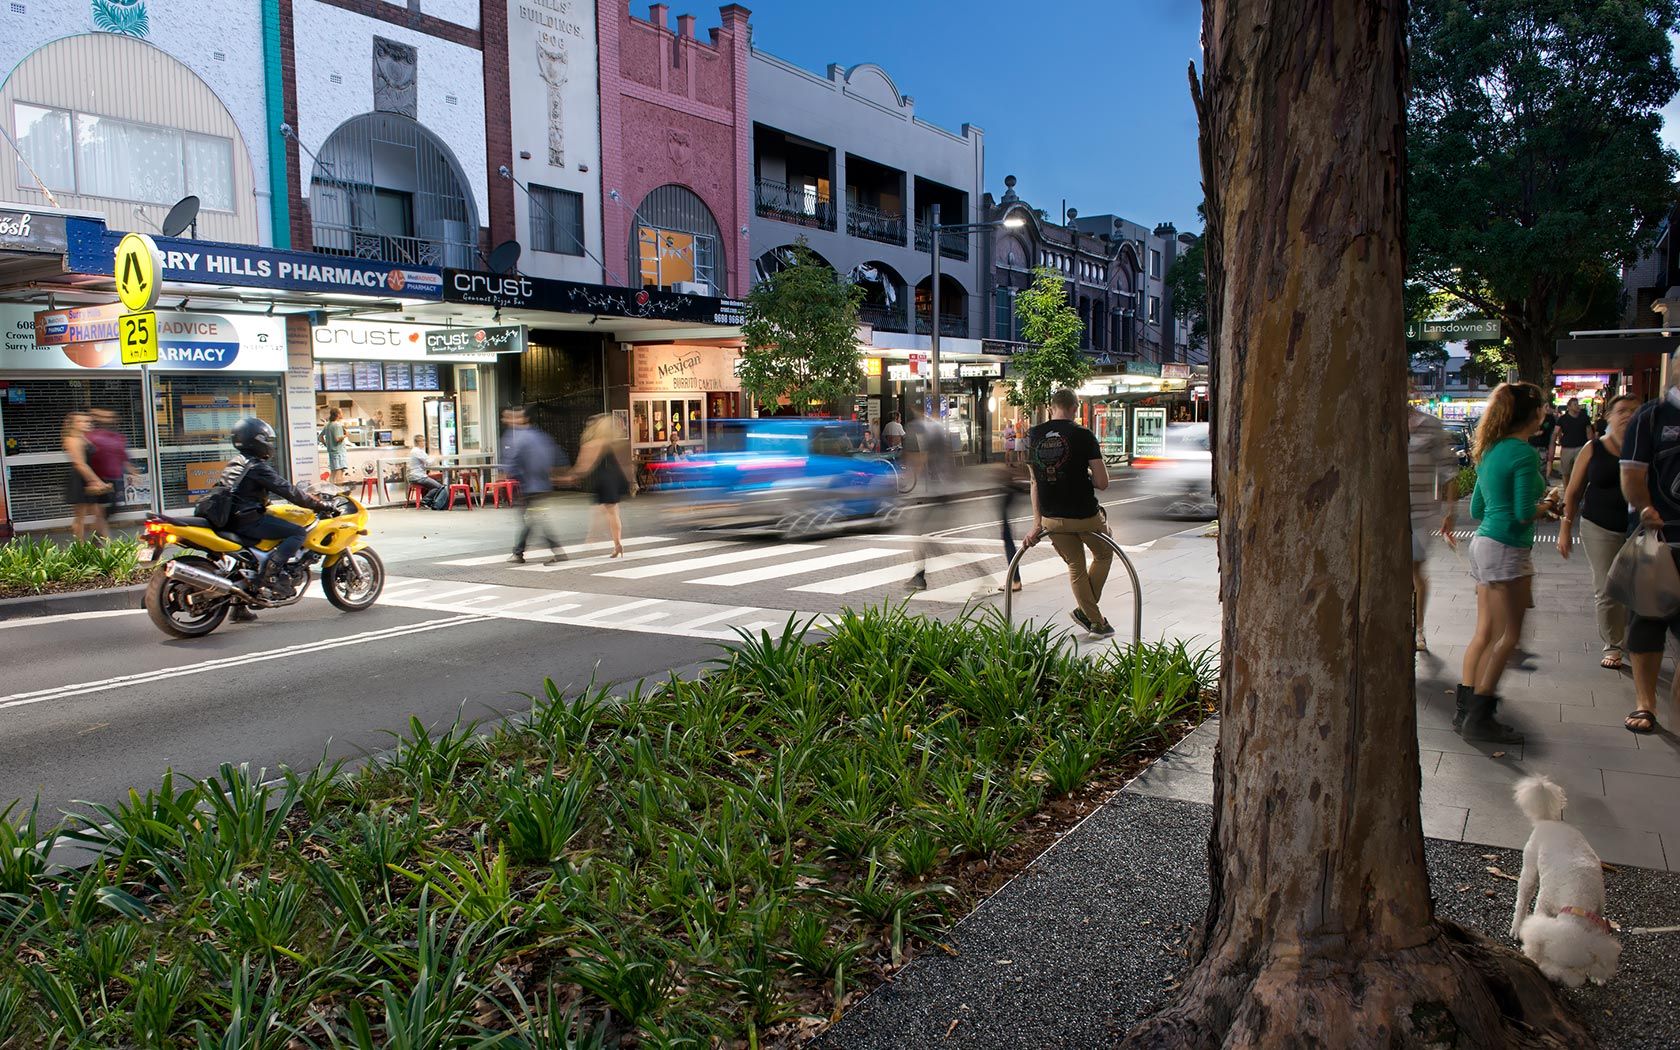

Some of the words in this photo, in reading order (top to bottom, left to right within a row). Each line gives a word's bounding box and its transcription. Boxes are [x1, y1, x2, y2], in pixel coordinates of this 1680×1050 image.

[206, 254, 271, 278] HILLS
[278, 261, 389, 288] PHARMACY
[406, 283, 437, 292] PHARMACY
[454, 273, 533, 297] crust
[17, 320, 35, 330] 608
[69, 322, 119, 341] PHARMAC
[126, 318, 149, 346] 25
[1423, 323, 1483, 333] Lansdowne
[1486, 322, 1497, 332] St
[5, 331, 34, 339] Crown
[314, 327, 402, 346] crust
[427, 331, 470, 347] crust
[5, 342, 27, 352] Surry
[130, 349, 148, 359] km/h
[158, 347, 226, 362] ARMACY
[657, 354, 702, 379] Mexican
[673, 377, 697, 389] BURRITO
